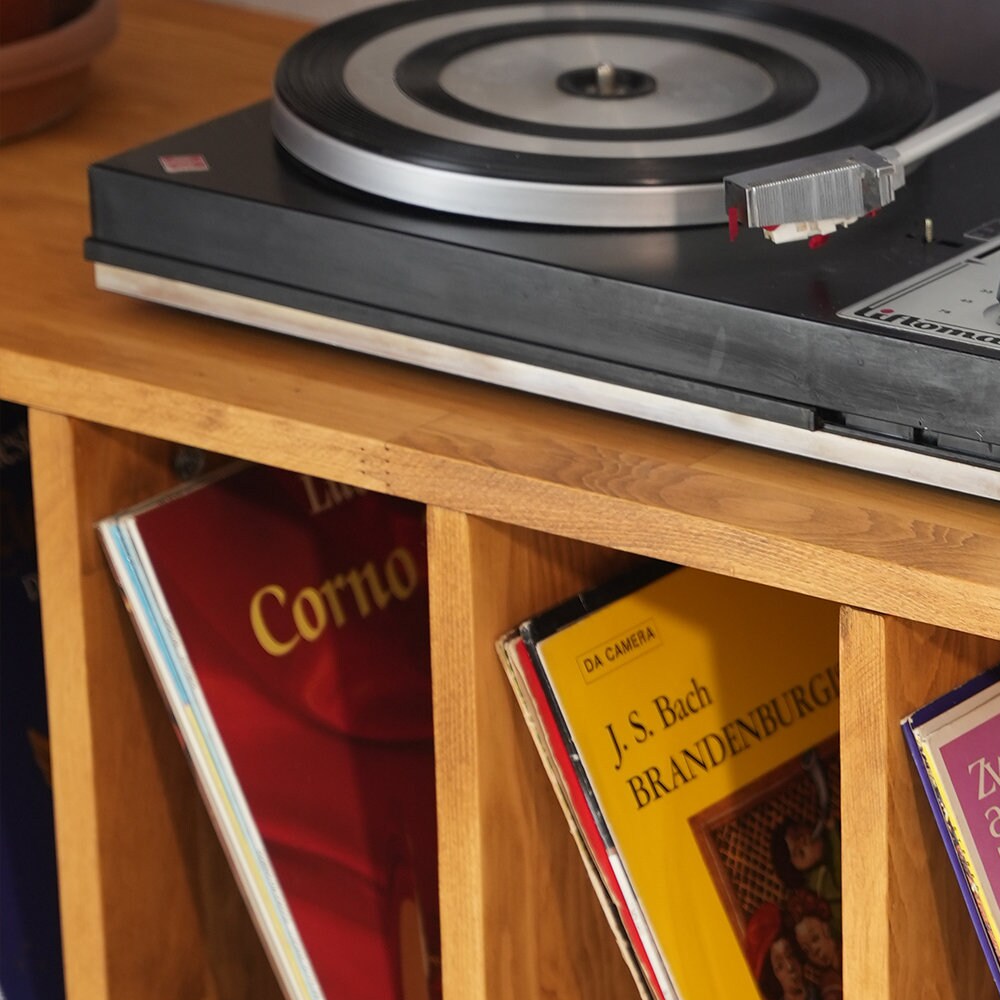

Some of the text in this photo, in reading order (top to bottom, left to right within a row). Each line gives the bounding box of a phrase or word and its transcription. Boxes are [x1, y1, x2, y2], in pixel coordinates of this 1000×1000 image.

[250, 547, 418, 657] Corno
[583, 625, 656, 674] DA CAMERA
[605, 677, 713, 771] J. S. Bach
[625, 663, 839, 811] BRANDENBURGI
